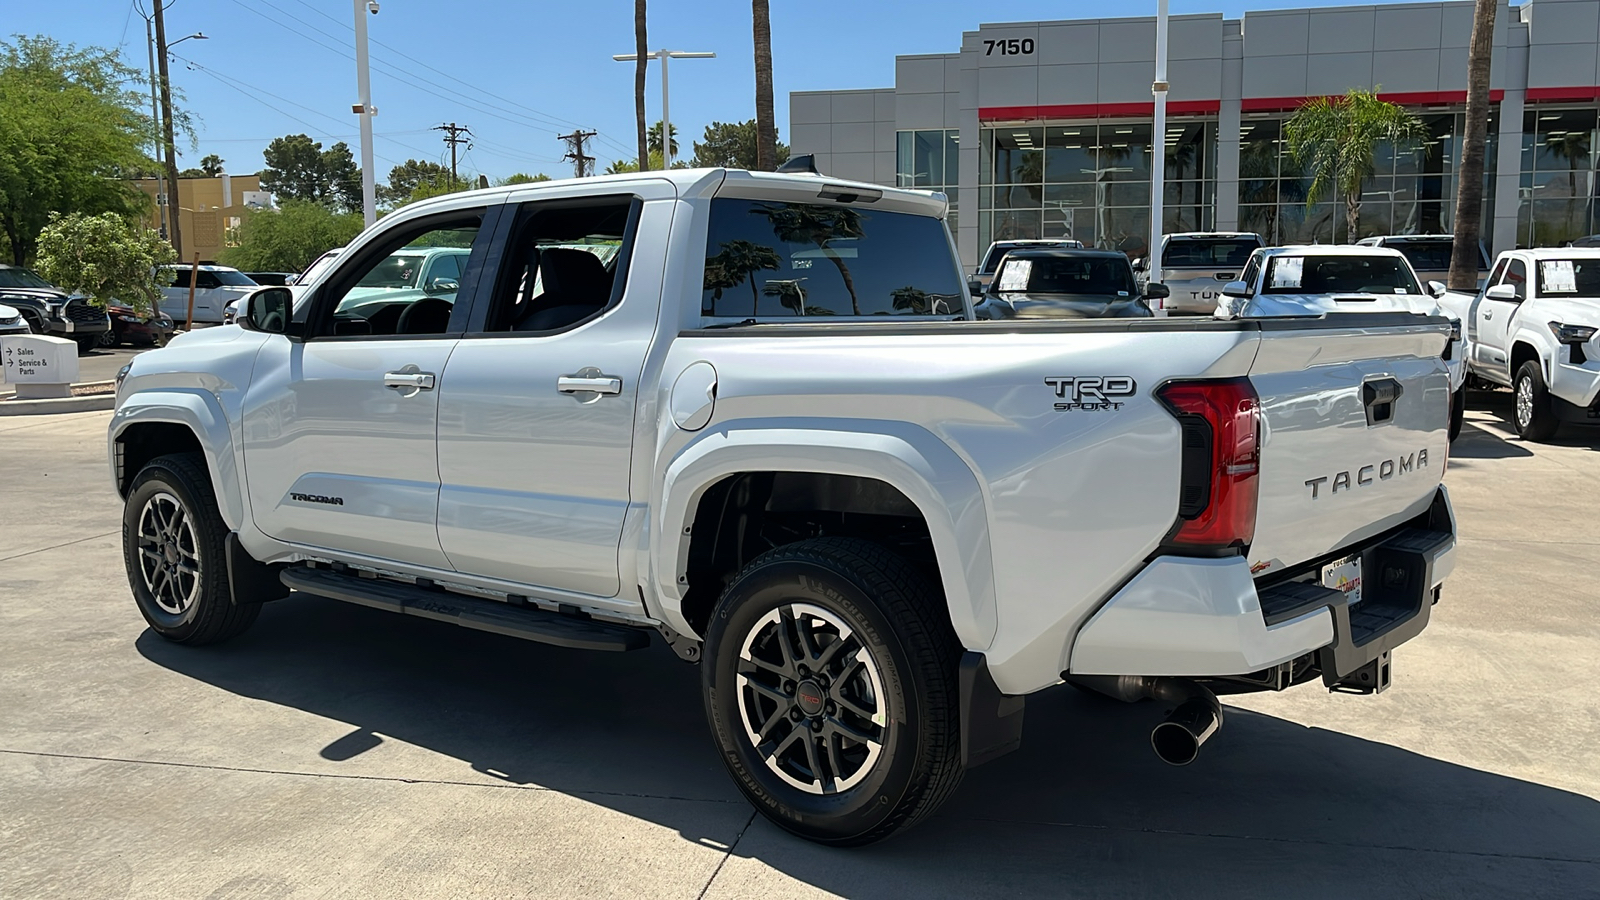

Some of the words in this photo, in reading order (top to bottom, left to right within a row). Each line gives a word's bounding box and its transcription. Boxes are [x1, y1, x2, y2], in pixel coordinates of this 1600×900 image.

[983, 38, 1035, 56] 7150
[1190, 291, 1221, 300] TUN
[17, 347, 34, 356] Sales
[18, 358, 41, 367] Service
[42, 358, 47, 367] &
[19, 367, 35, 375] Parts
[1044, 376, 1137, 404] TRD
[1053, 402, 1125, 412] SPORT
[1304, 448, 1429, 500] TACOMA
[289, 492, 344, 506] TACOMA
[826, 588, 881, 647] MICHELIN
[884, 653, 902, 696] PRIMACY
[800, 692, 820, 704] TRD
[729, 752, 778, 809] MICHELIN
